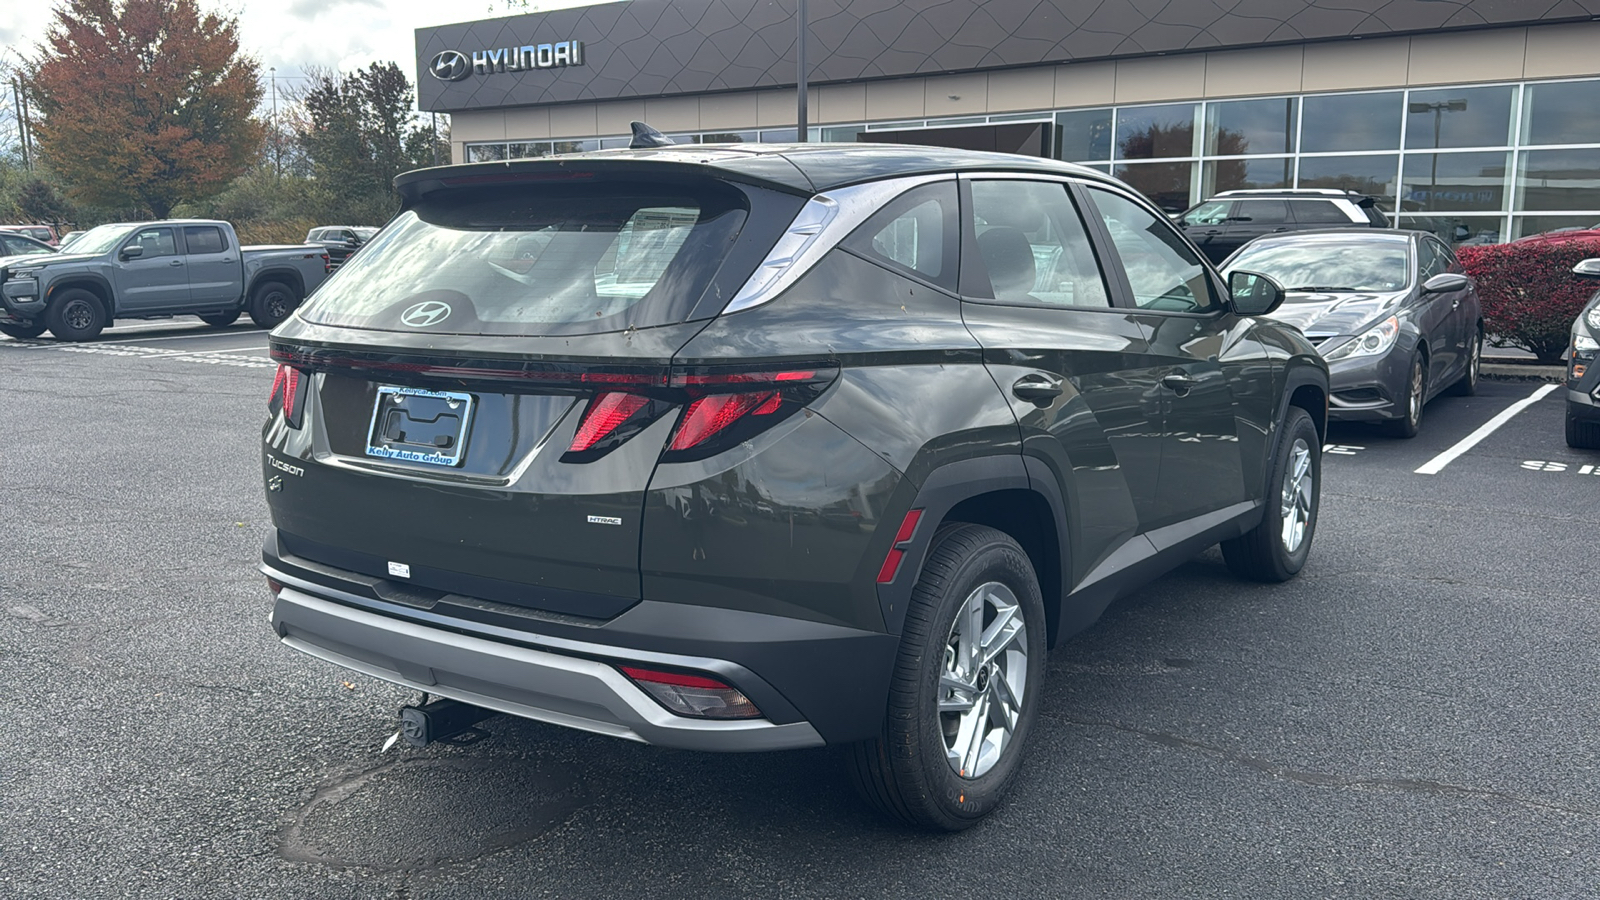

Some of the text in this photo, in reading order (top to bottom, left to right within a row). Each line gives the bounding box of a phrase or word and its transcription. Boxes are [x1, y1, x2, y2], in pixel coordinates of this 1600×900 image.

[472, 40, 580, 73] HYUNDAI
[368, 447, 452, 465] Kelly Auto Group
